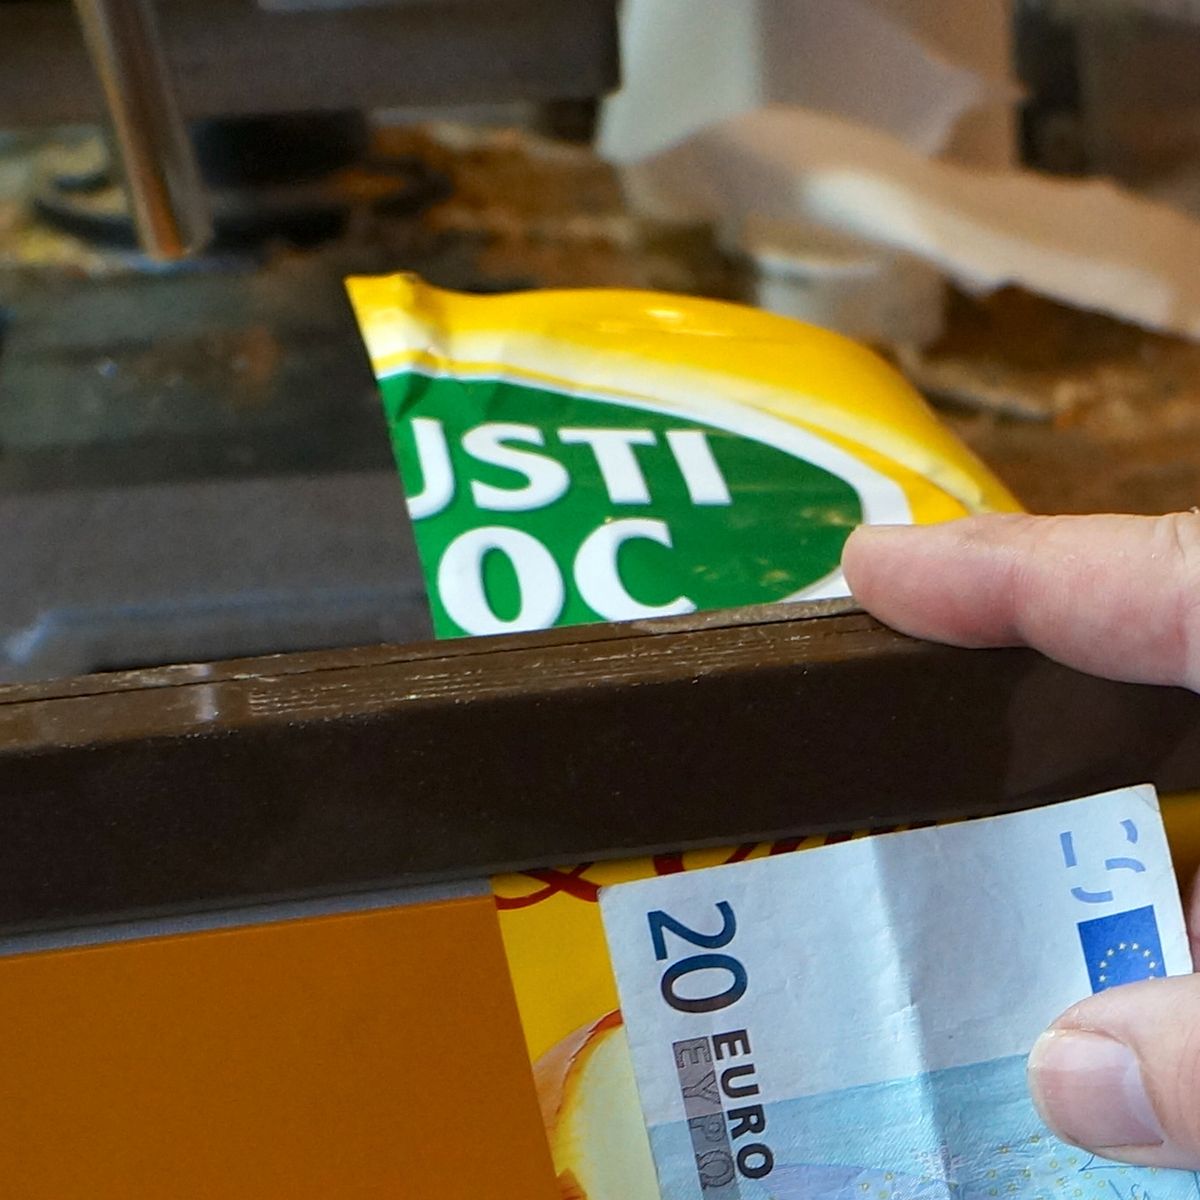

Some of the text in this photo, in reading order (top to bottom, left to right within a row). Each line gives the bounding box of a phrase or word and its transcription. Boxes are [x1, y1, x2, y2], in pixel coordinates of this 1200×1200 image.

[437, 520, 697, 637] OC
[647, 900, 774, 1180] 20 EURO
